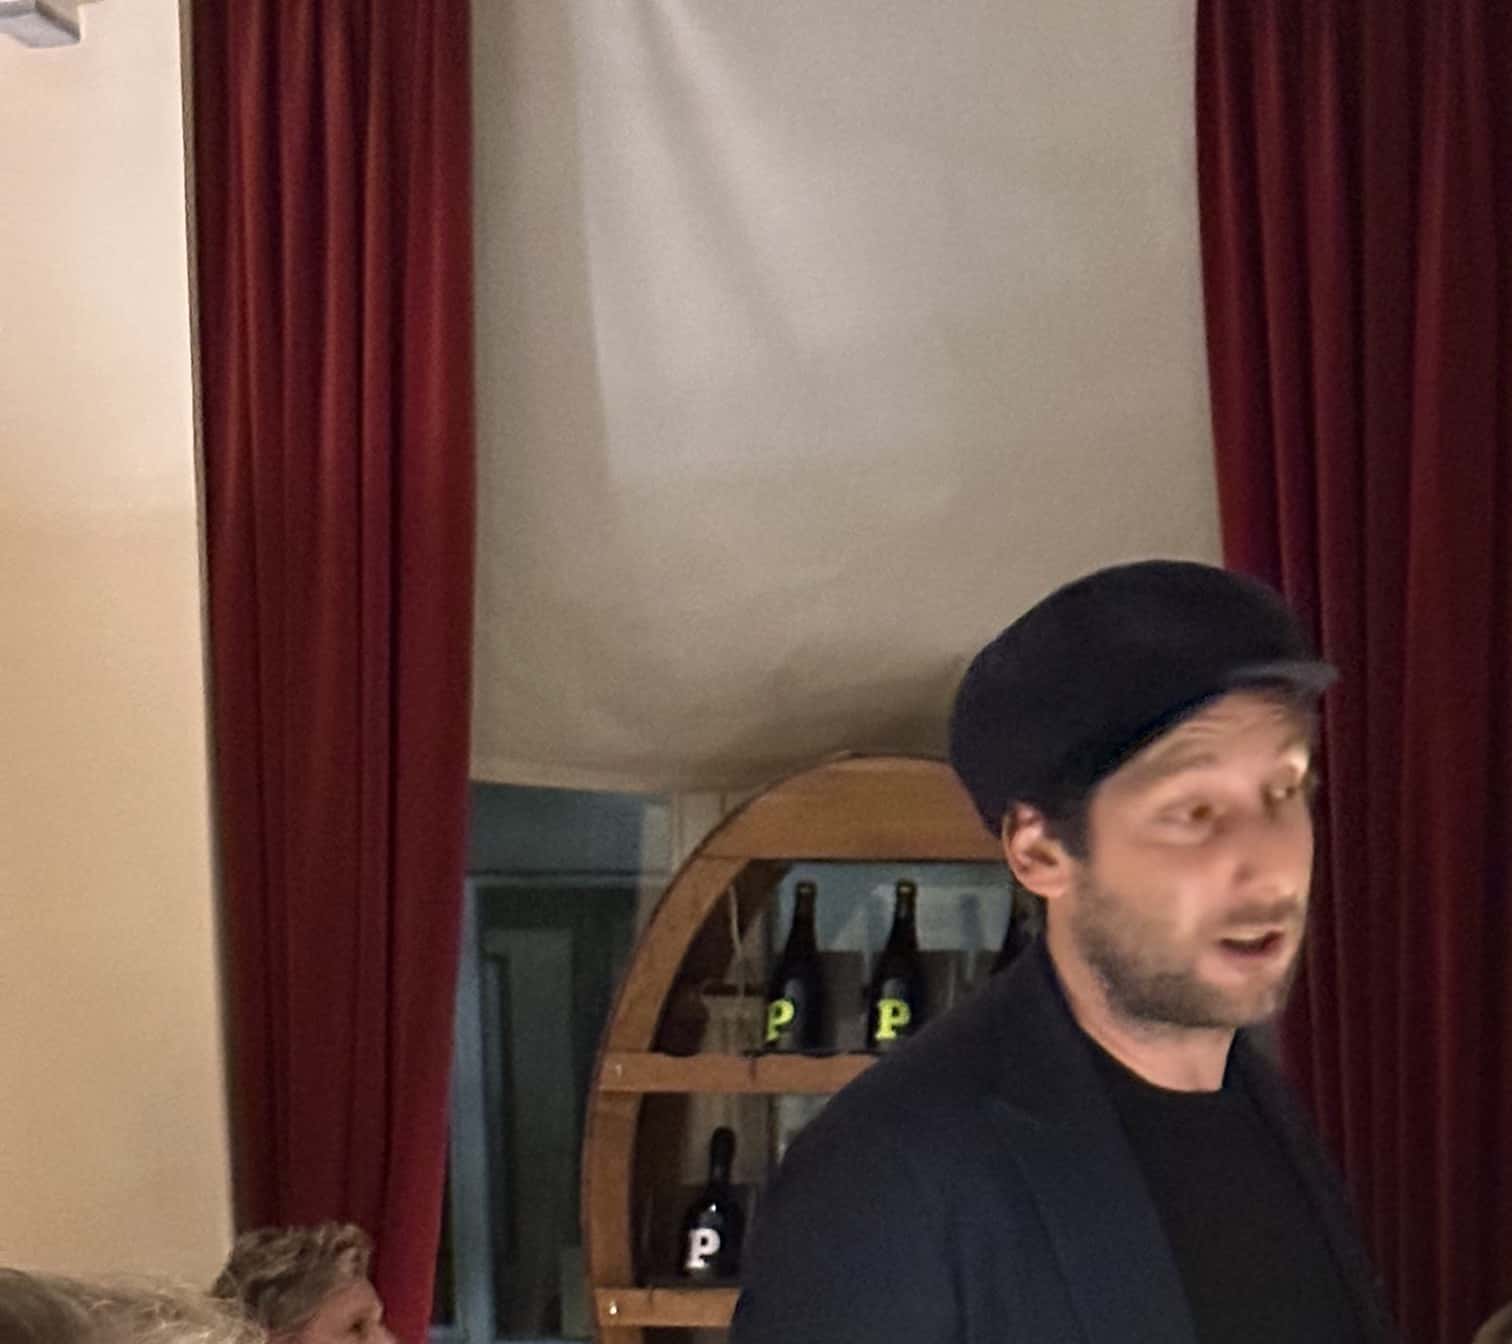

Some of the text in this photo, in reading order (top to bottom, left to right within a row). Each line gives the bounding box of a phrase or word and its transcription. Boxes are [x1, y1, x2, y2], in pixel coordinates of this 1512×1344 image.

[767, 999, 795, 1041] P
[874, 998, 912, 1040] P
[686, 1228, 721, 1269] P
